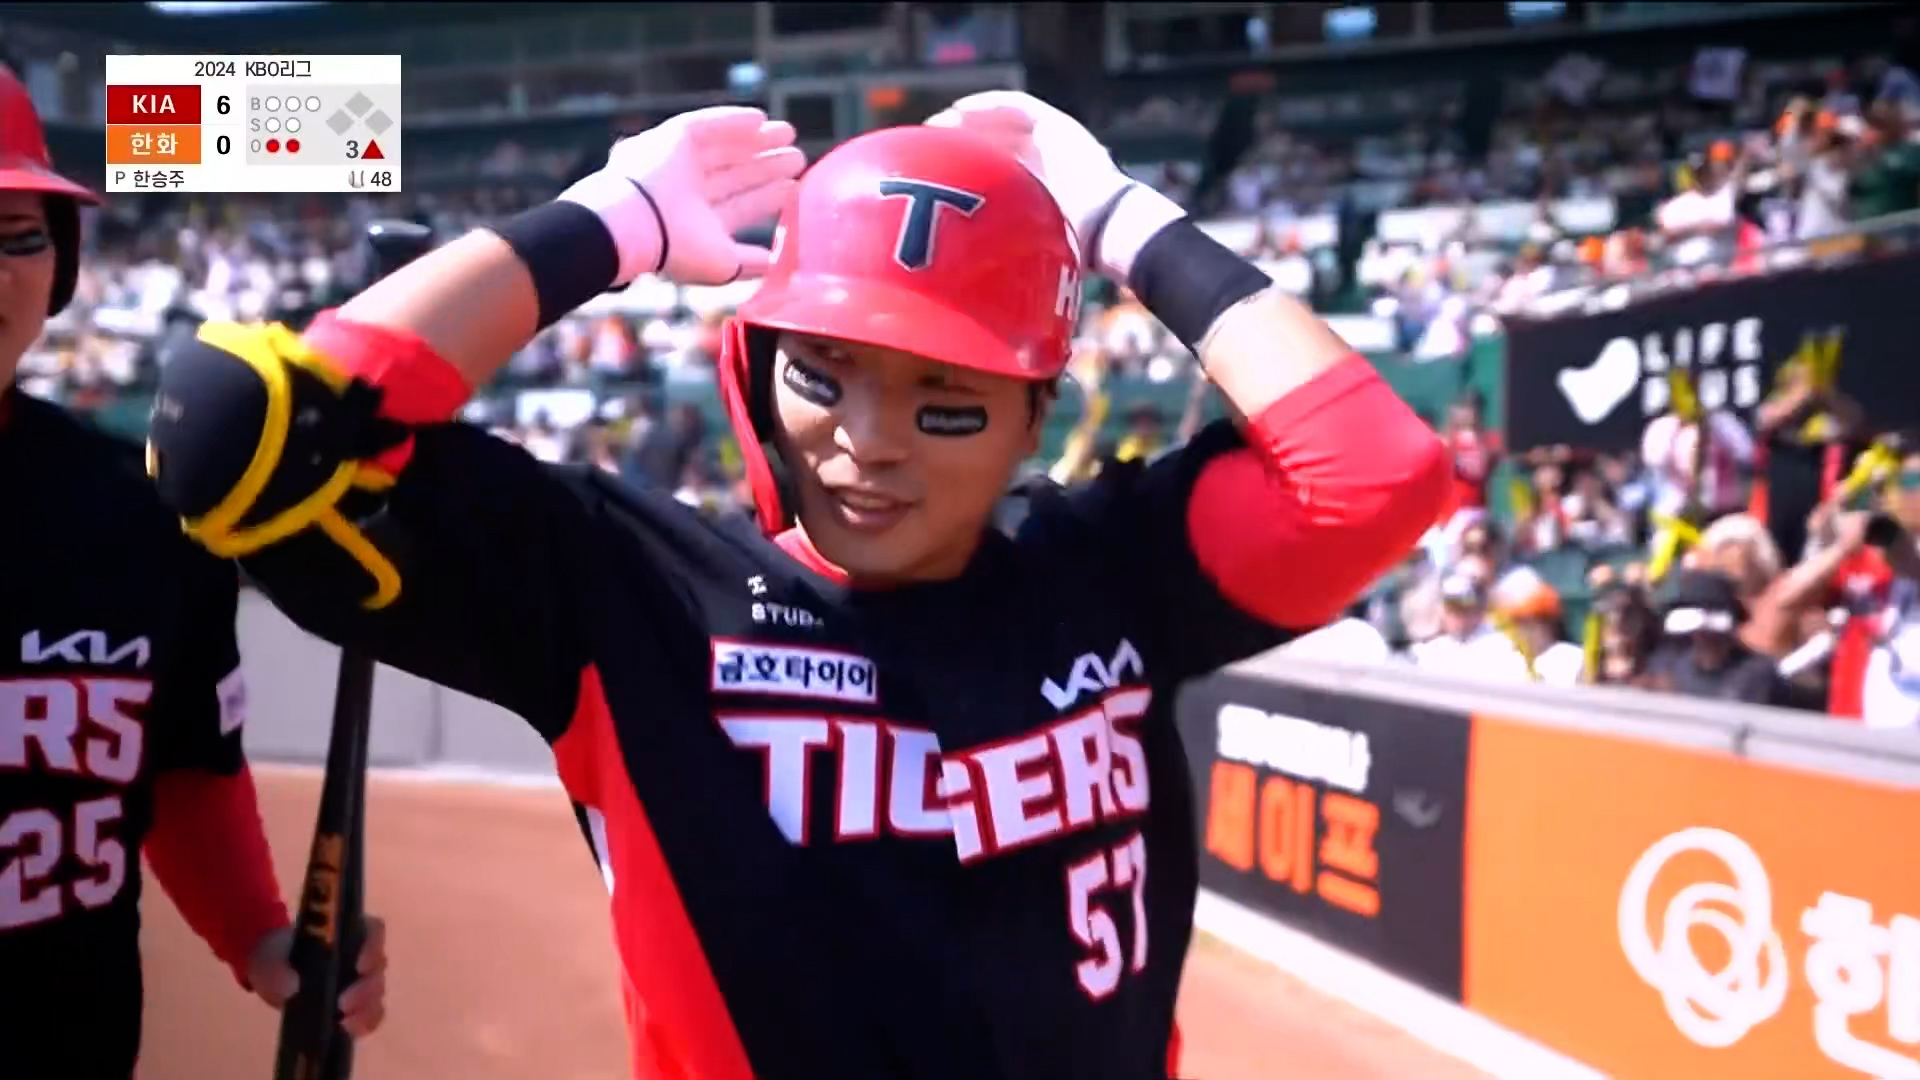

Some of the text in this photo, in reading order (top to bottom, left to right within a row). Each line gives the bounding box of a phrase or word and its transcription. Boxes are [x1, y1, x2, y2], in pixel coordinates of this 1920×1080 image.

[879, 177, 985, 272] T
[1642, 316, 1763, 372] LIFE
[716, 685, 1152, 864] TIGERS
[0, 797, 126, 932] 25
[1064, 832, 1148, 1001] 57
